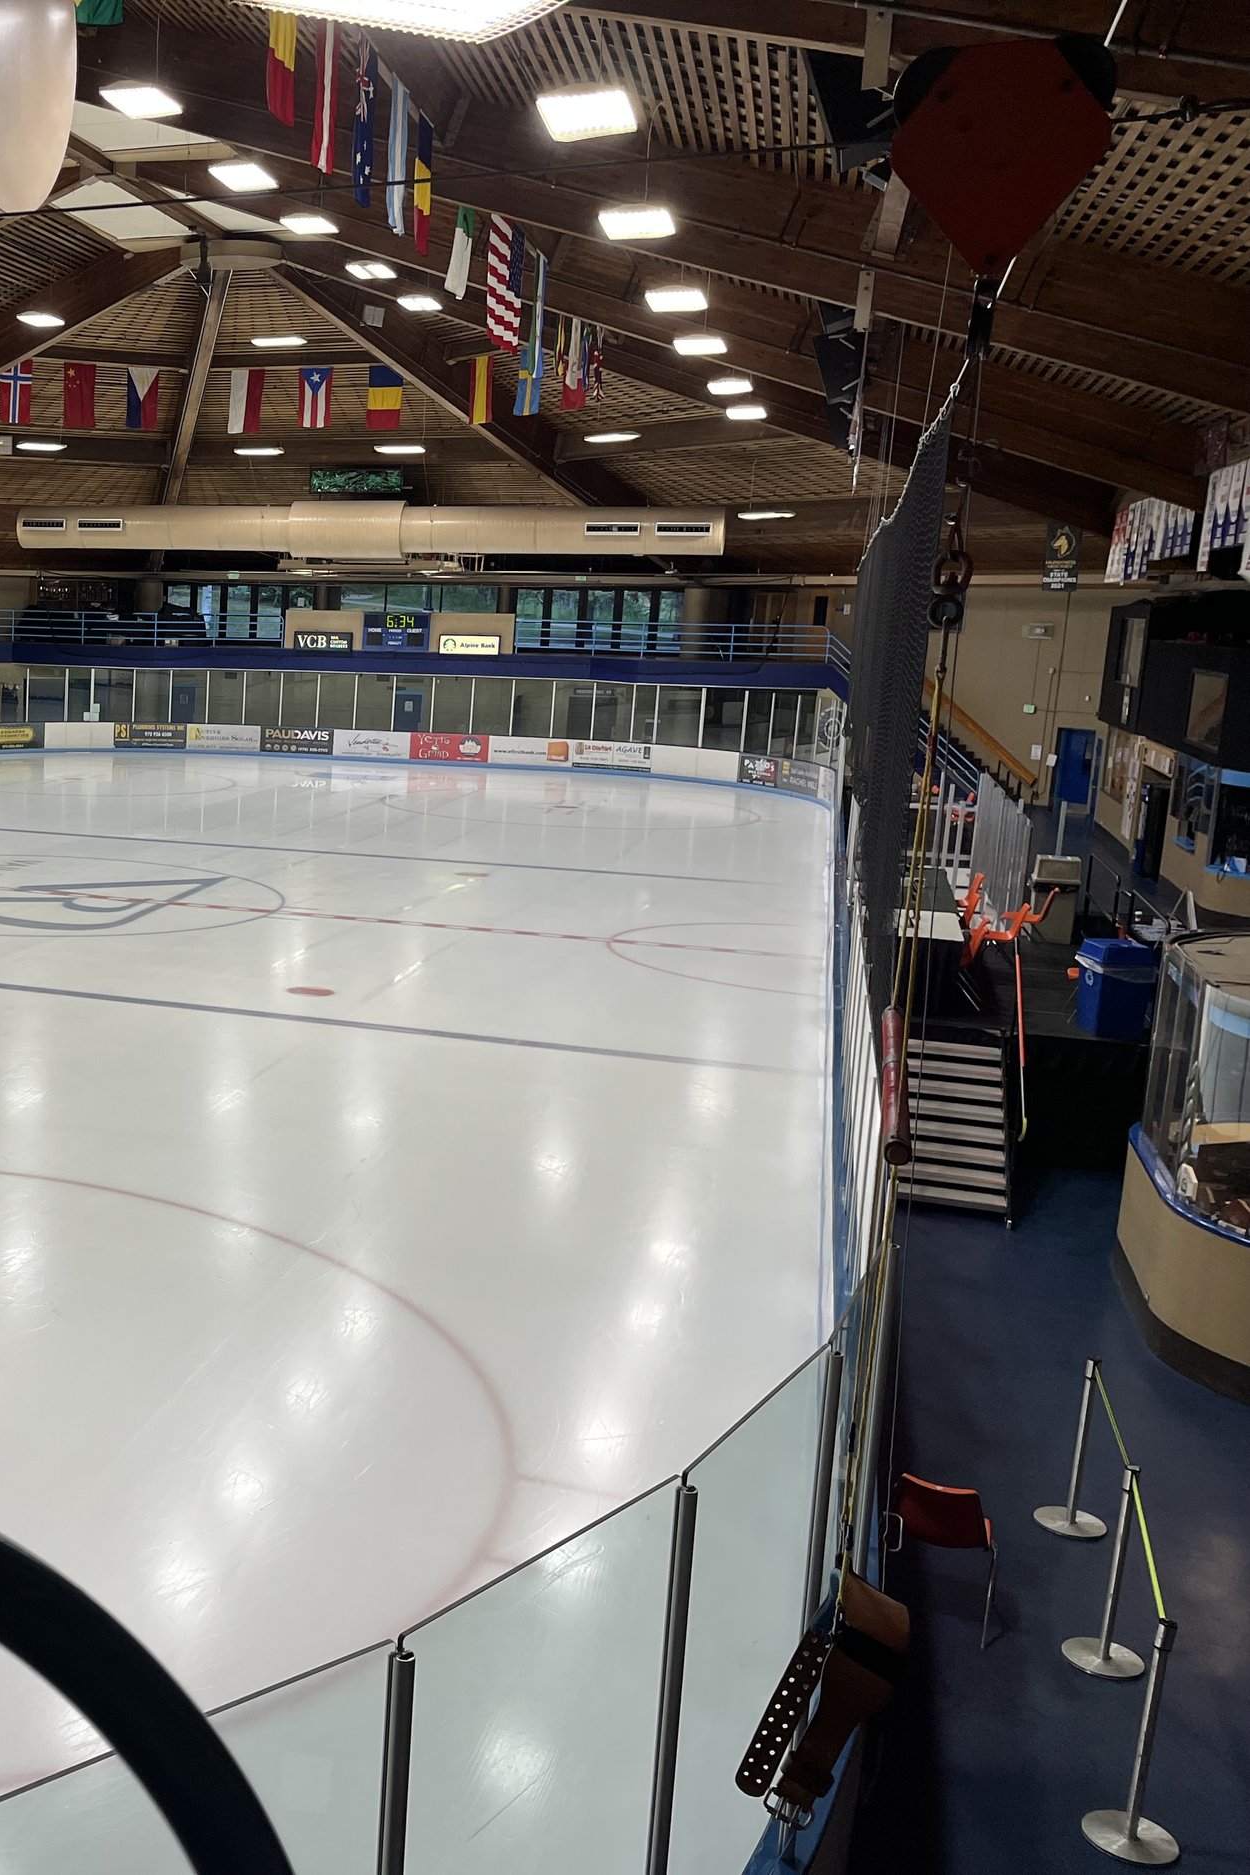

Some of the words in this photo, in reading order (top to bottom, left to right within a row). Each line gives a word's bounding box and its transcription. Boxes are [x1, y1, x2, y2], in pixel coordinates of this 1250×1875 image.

[386, 615, 414, 628] 6:34
[297, 634, 327, 648] VCB
[459, 641, 479, 650] Alpine
[480, 641, 496, 649] Bank
[115, 724, 129, 738] PSI
[616, 746, 643, 754] AGAVE
